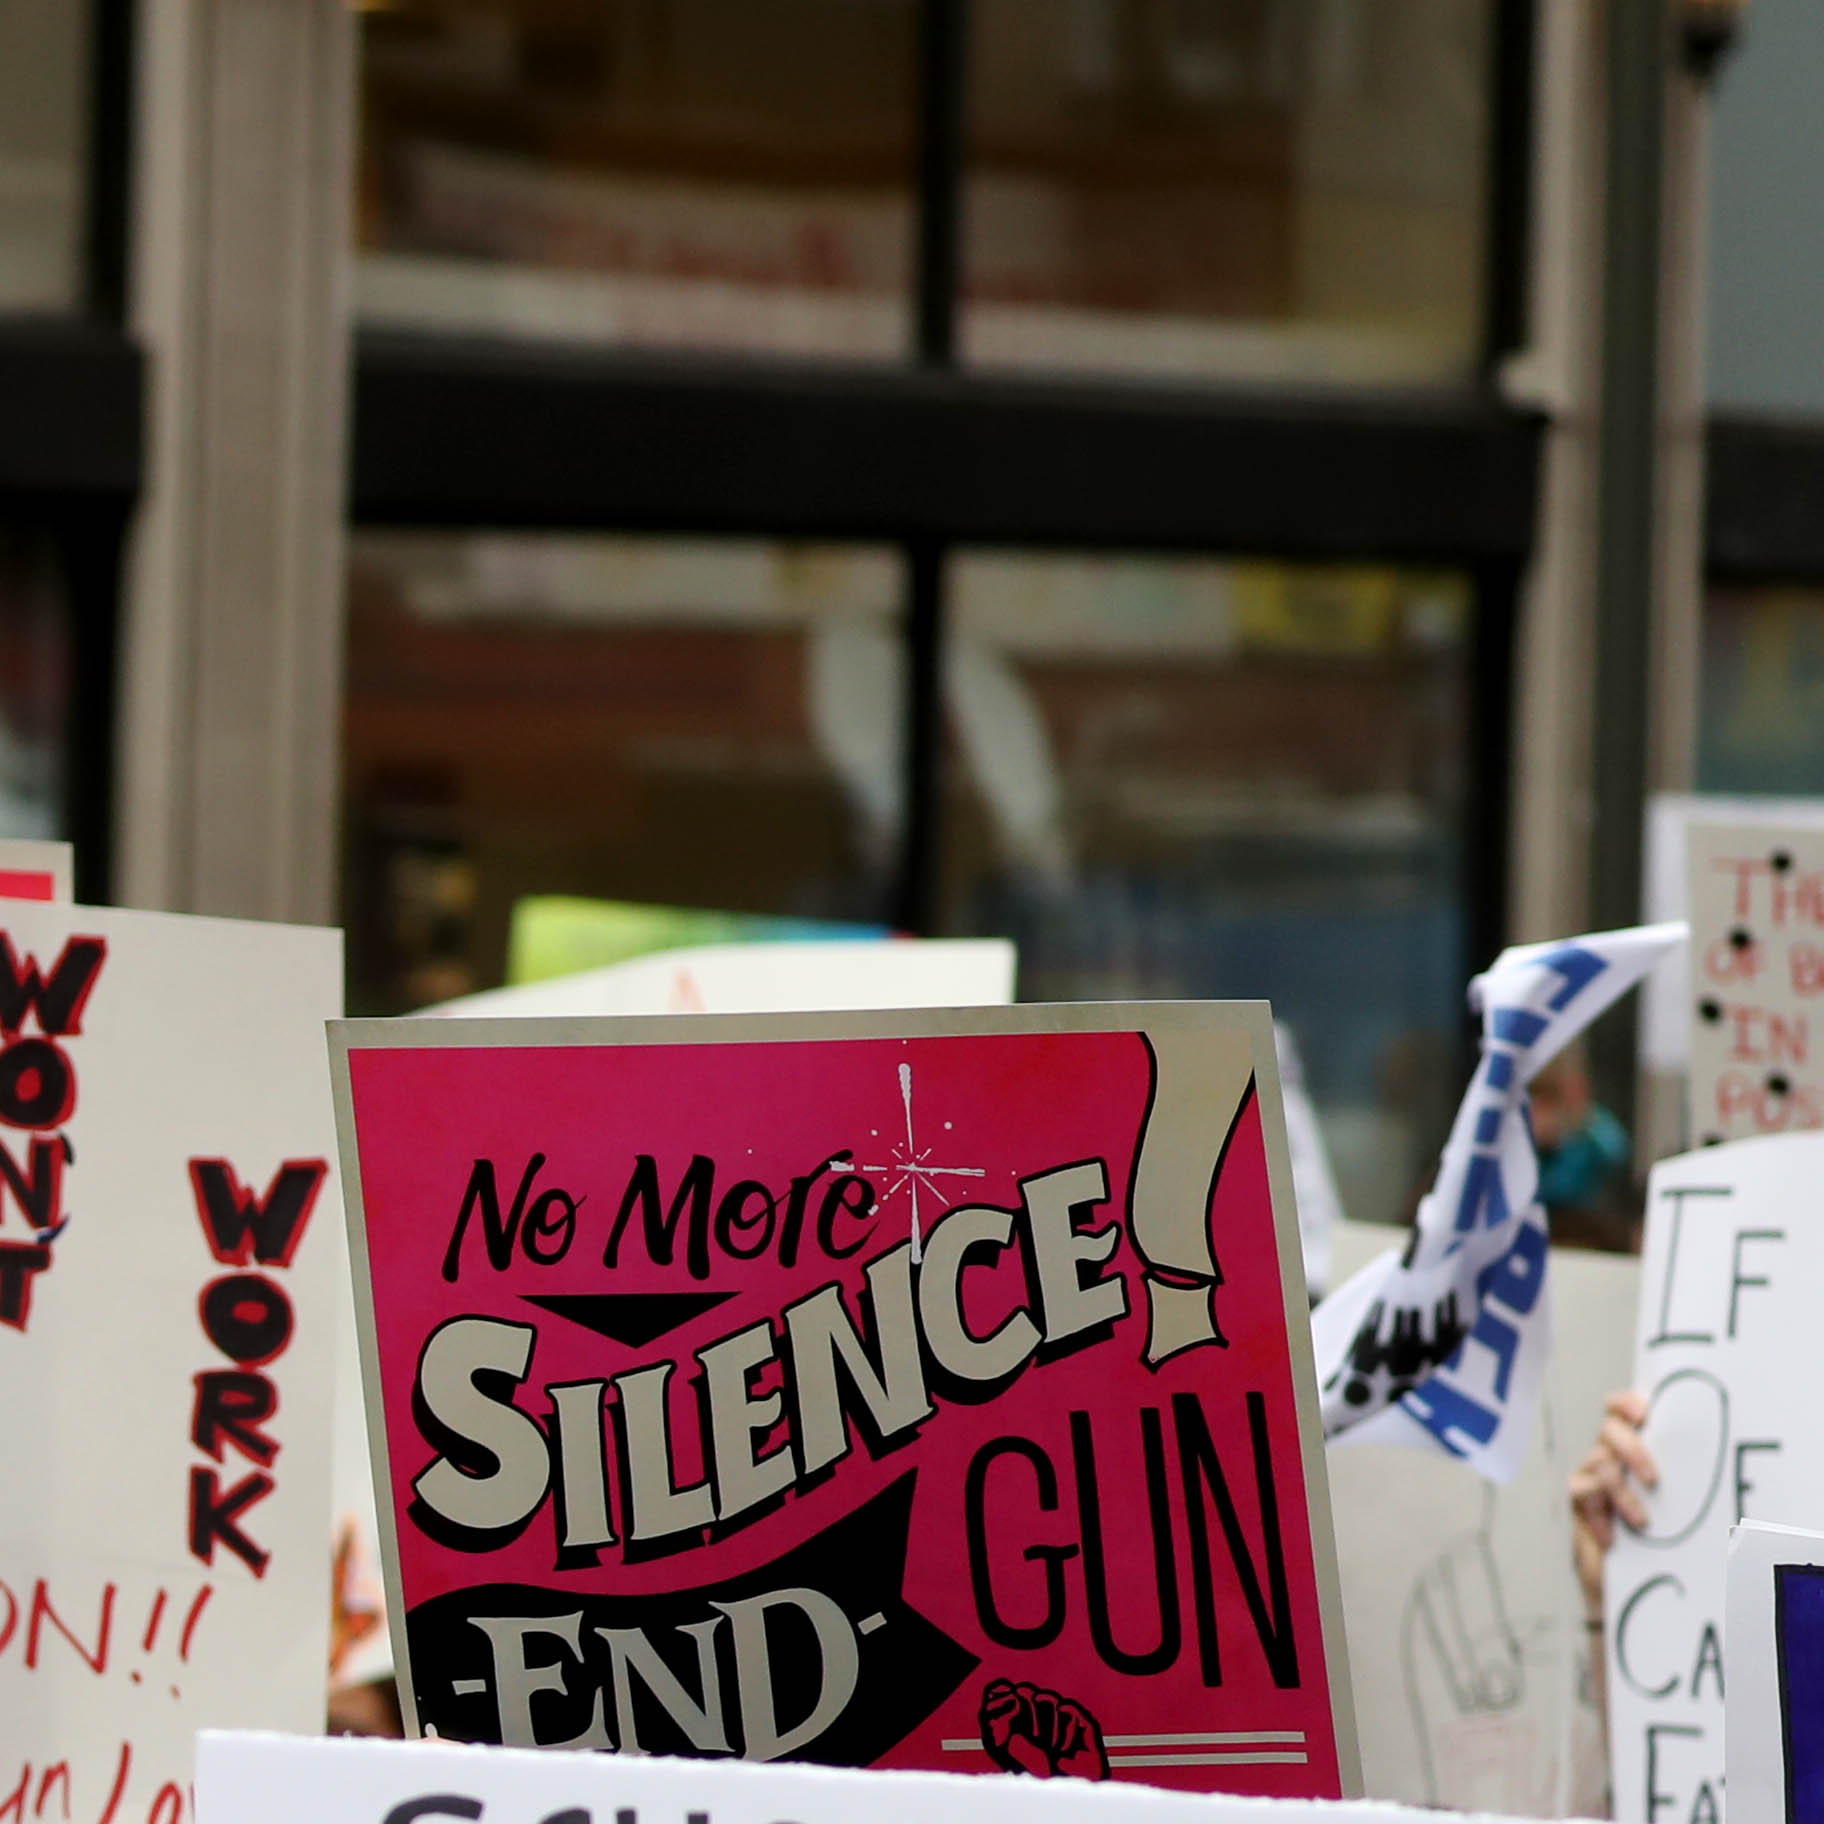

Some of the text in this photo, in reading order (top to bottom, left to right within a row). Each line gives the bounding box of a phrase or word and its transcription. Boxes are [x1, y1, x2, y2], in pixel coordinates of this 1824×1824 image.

[442, 1150, 880, 1282] No More
[188, 1157, 329, 1580] WORK
[963, 1390, 1301, 1690] GUN
